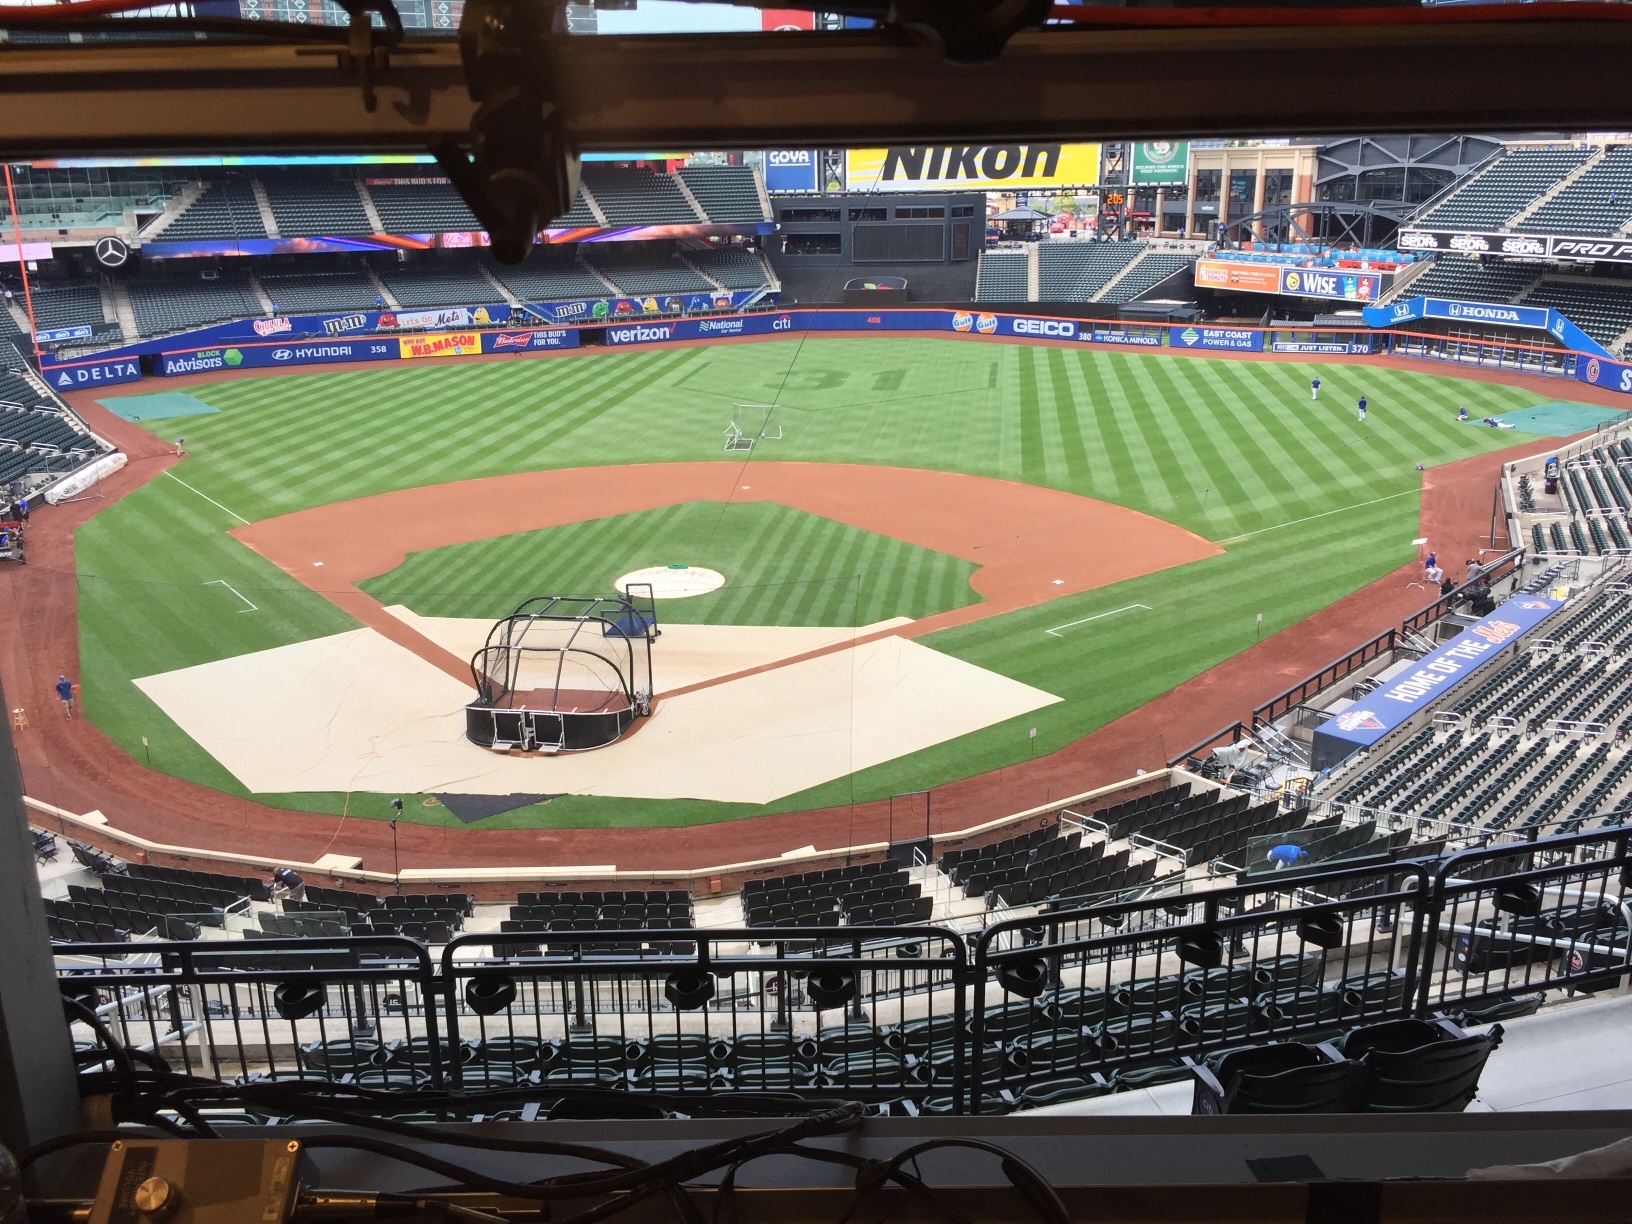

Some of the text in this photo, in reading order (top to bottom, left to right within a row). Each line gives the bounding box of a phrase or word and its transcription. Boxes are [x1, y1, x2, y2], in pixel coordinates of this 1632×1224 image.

[769, 150, 810, 164] GOYA
[1552, 241, 1615, 256] PRO
[1462, 307, 1520, 321] HONDA
[709, 319, 743, 329] National
[773, 317, 791, 330] citi
[953, 319, 971, 327] Gulf
[977, 320, 996, 329] Gulf
[1013, 319, 1074, 336] GEICO
[534, 330, 566, 339] THIS BUD'S
[611, 326, 670, 342] verizon
[1103, 335, 1158, 345] KONICA MINOLTA
[1225, 331, 1252, 339] COAST
[497, 336, 530, 345] Budweiser
[197, 350, 220, 359] BLOCK
[296, 346, 352, 358] HYUNDAI
[1351, 345, 1369, 353] 370
[166, 357, 223, 374] Advisors
[77, 363, 138, 382] DELTA
[1384, 670, 1447, 703] HOME
[1427, 657, 1463, 674] OF
[1445, 639, 1492, 660] THE
